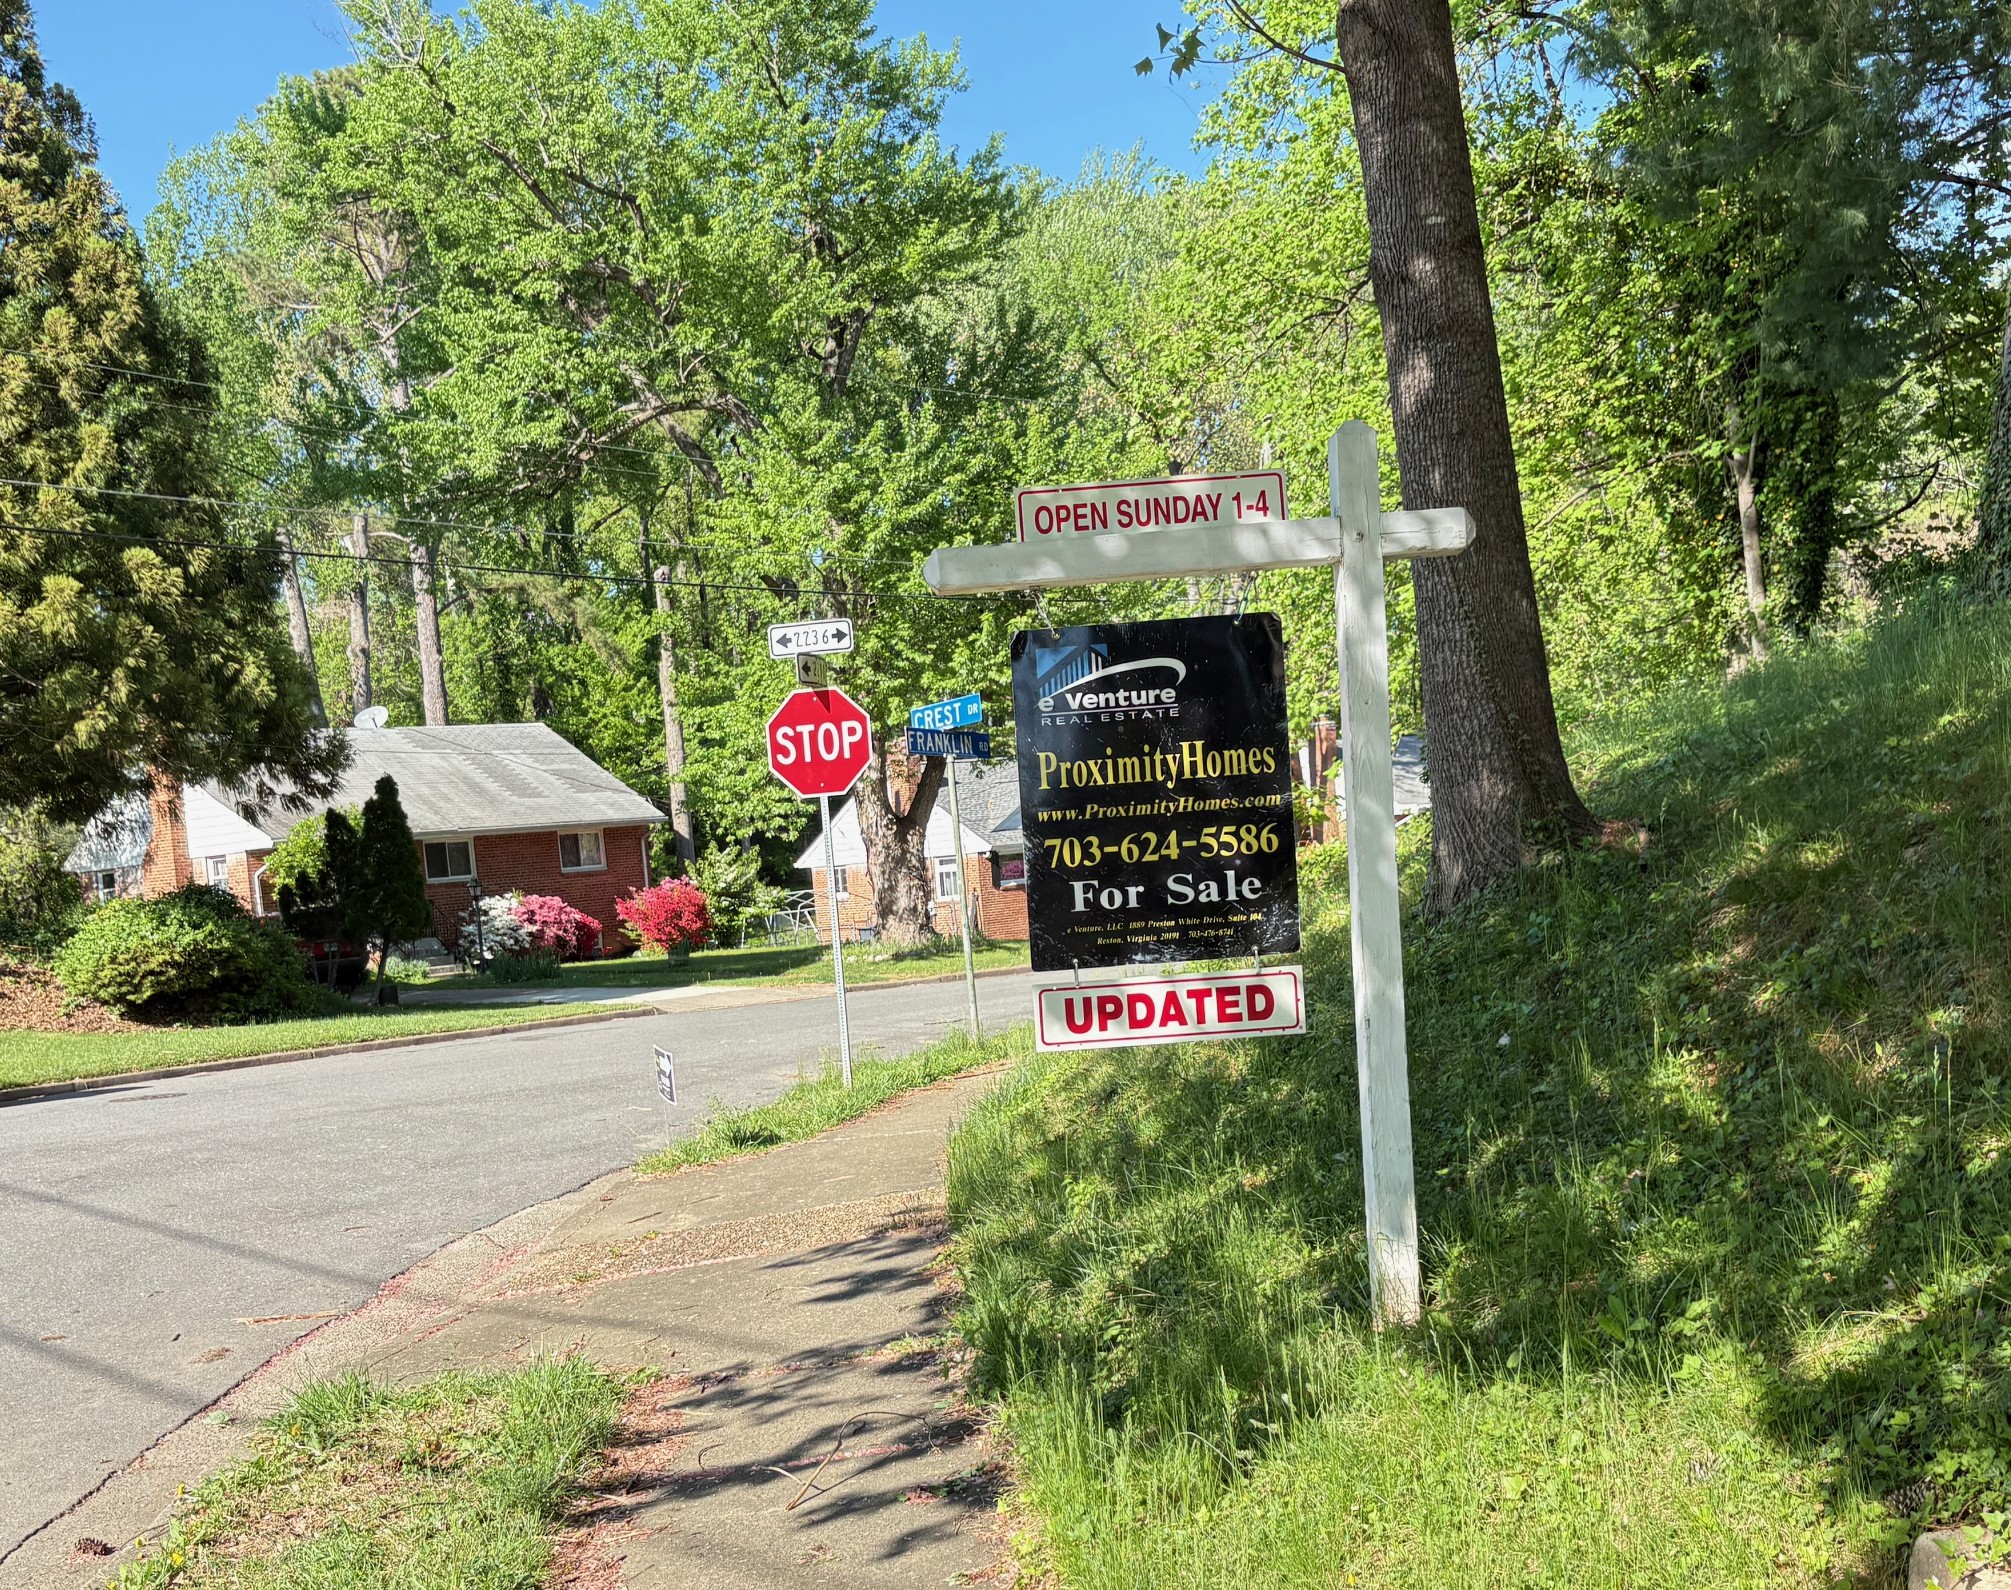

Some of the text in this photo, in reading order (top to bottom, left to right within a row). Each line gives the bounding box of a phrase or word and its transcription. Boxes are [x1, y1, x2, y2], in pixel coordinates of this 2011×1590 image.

[1034, 489, 1269, 535] OPEN SUNDAY 1-4
[793, 628, 829, 648] 2236
[1038, 687, 1176, 712] e Venture
[914, 702, 979, 729] CREST DR
[1041, 707, 1180, 726] REAL ESTATE
[775, 720, 863, 765] STOP
[907, 730, 989, 755] FRANKLIN RD
[1037, 740, 1276, 790] ProximityHomes
[1037, 793, 1281, 822] www.ProximityHomes.com
[1043, 822, 1280, 869] 703-624-5586
[1069, 869, 1263, 912] For Sale
[1107, 922, 1124, 931] LLC
[1148, 919, 1176, 929] Preston
[1178, 917, 1200, 926] White
[1228, 913, 1248, 923] Suite
[1097, 937, 1124, 945] Reston,
[1126, 934, 1157, 944] Virginia
[1064, 984, 1275, 1035] UPDATED
